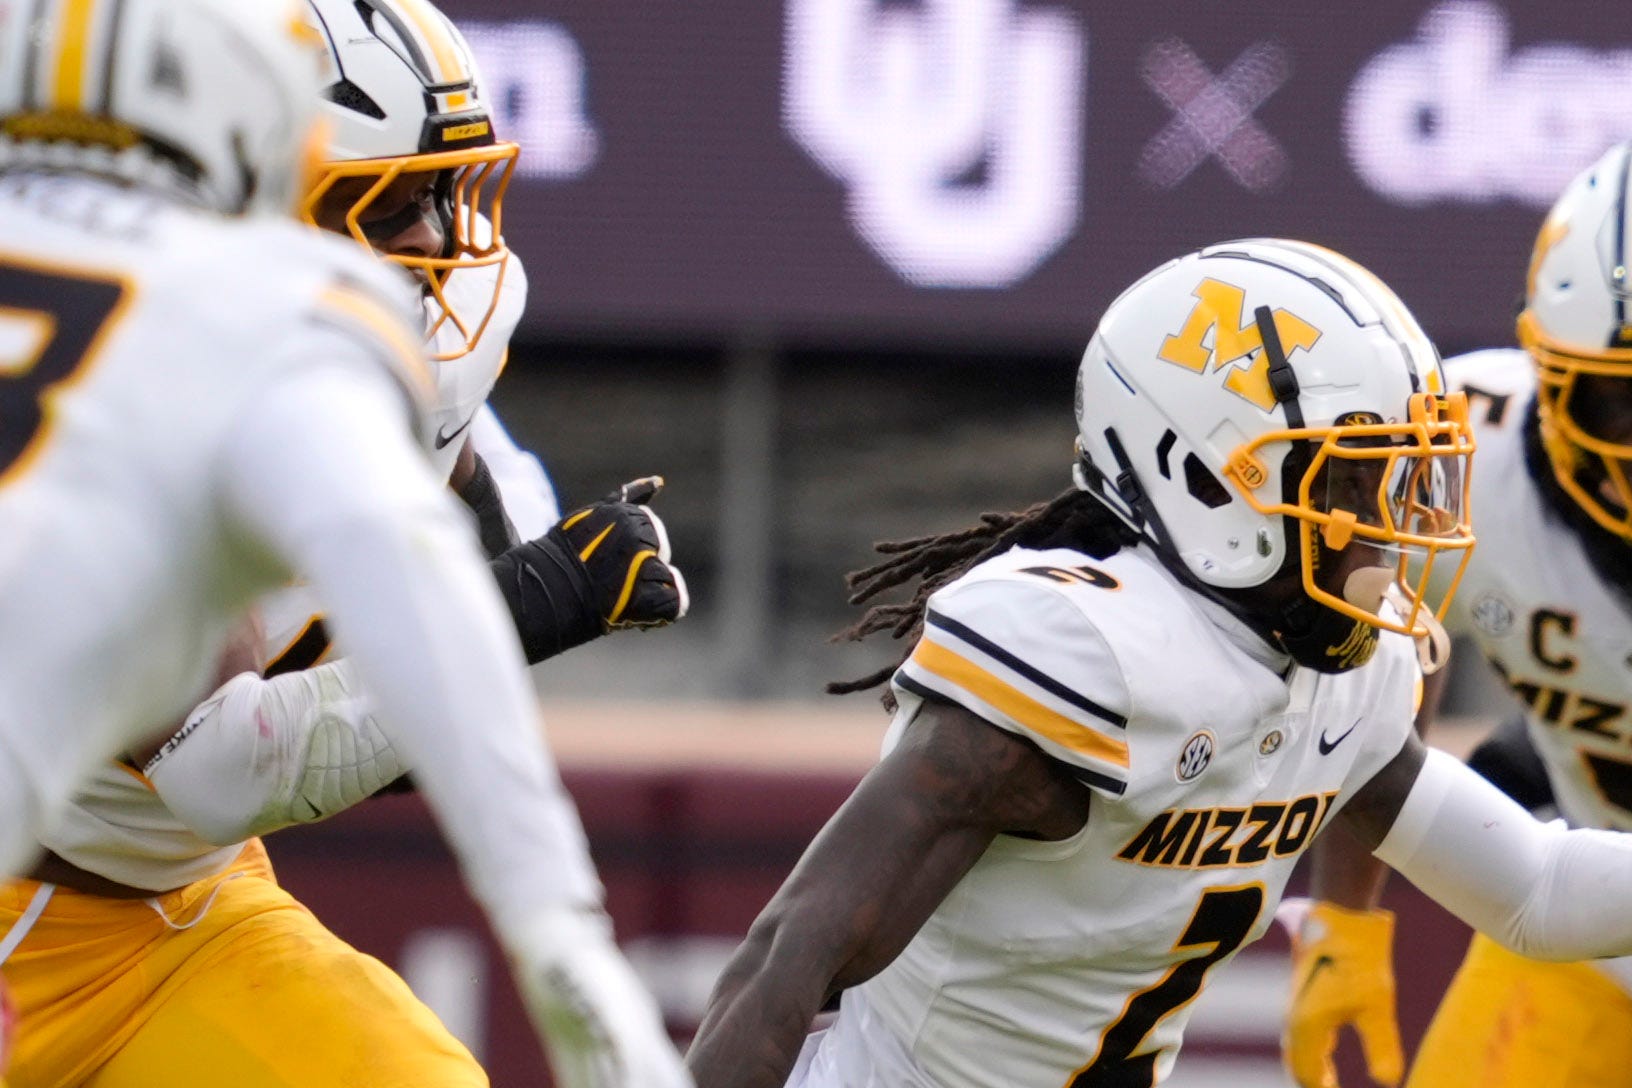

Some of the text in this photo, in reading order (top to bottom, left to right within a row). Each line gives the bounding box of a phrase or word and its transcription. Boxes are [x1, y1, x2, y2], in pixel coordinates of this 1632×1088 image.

[1157, 277, 1323, 414] M
[1014, 564, 1123, 591] 2
[1528, 605, 1580, 675] C
[1177, 731, 1215, 781] SEC
